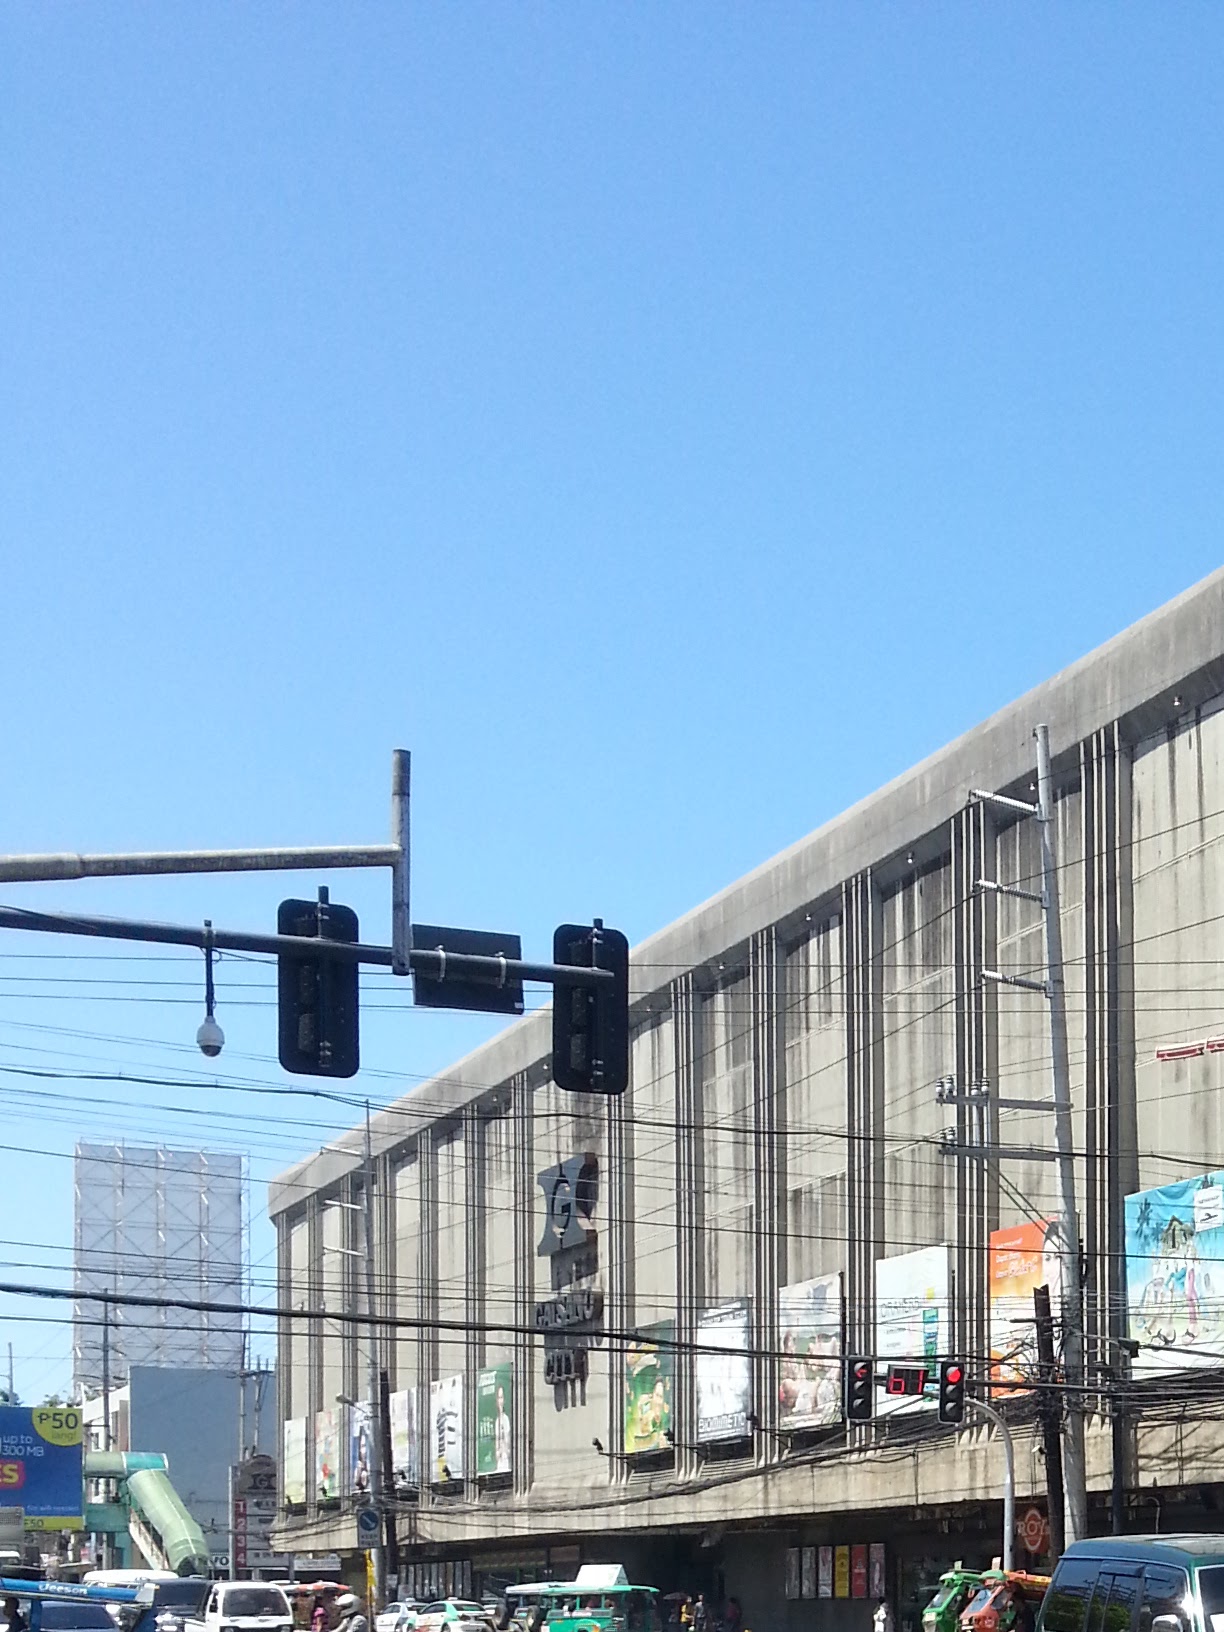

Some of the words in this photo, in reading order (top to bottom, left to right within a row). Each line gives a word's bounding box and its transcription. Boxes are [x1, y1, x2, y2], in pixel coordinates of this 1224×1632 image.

[3, 1435, 18, 1446] up
[21, 1434, 33, 1444] to
[26, 1446, 45, 1457] MB
[38, 1583, 88, 1595] Jeeson
